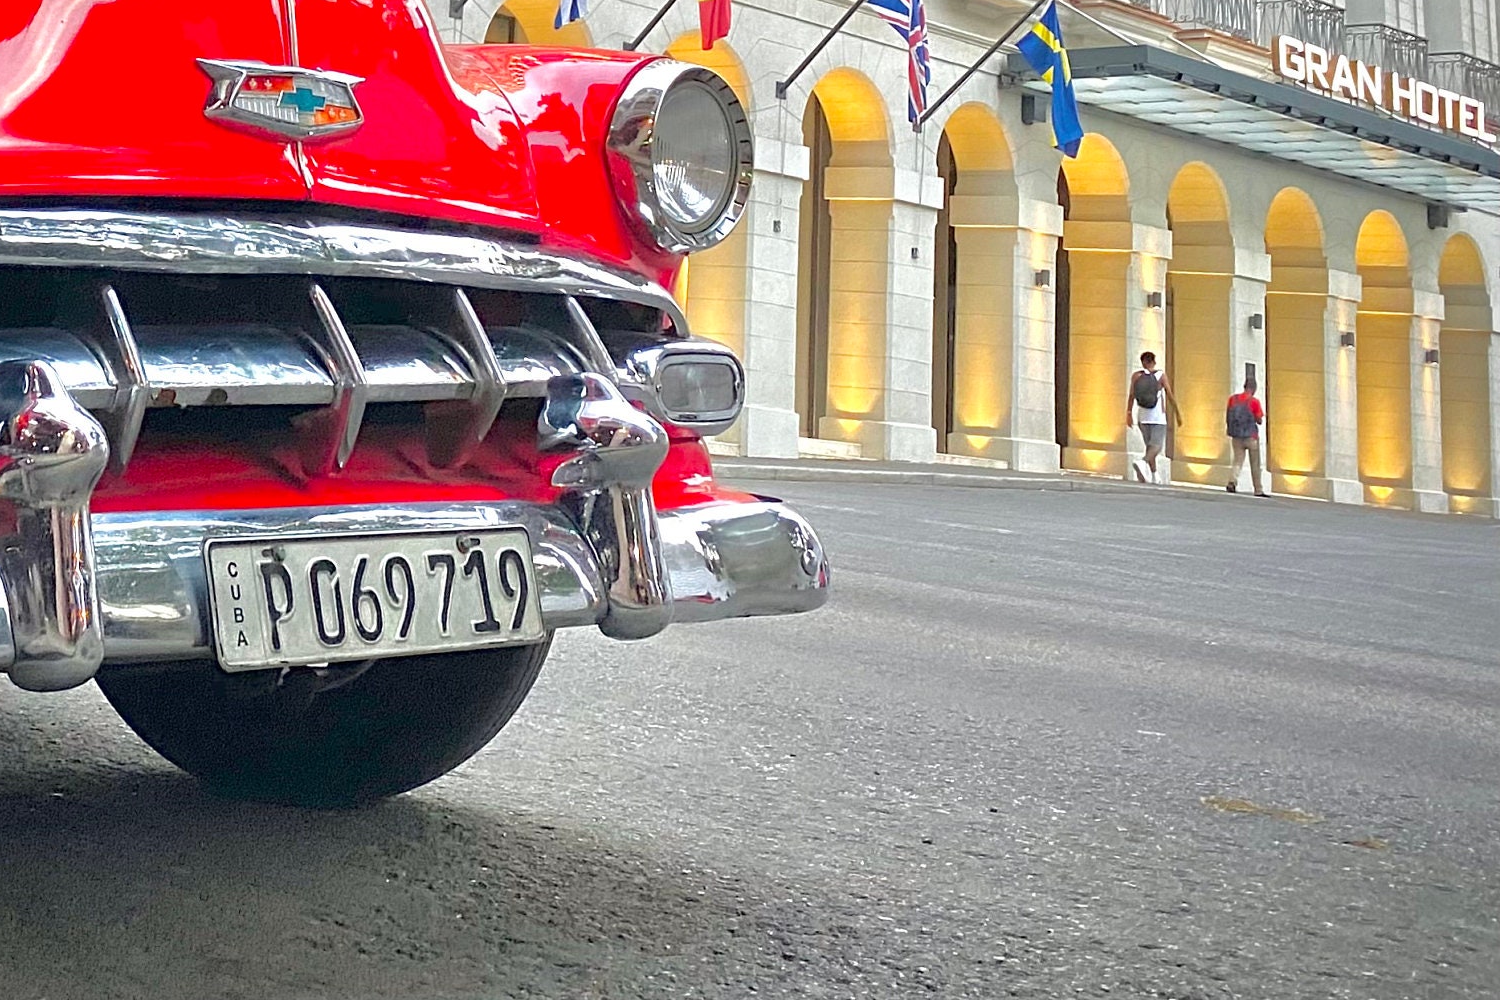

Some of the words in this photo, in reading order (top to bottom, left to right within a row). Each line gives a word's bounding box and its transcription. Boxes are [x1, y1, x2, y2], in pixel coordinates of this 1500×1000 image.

[1278, 34, 1383, 106] GRAN
[1391, 71, 1497, 143] HOTEL
[226, 561, 248, 647] CUBA
